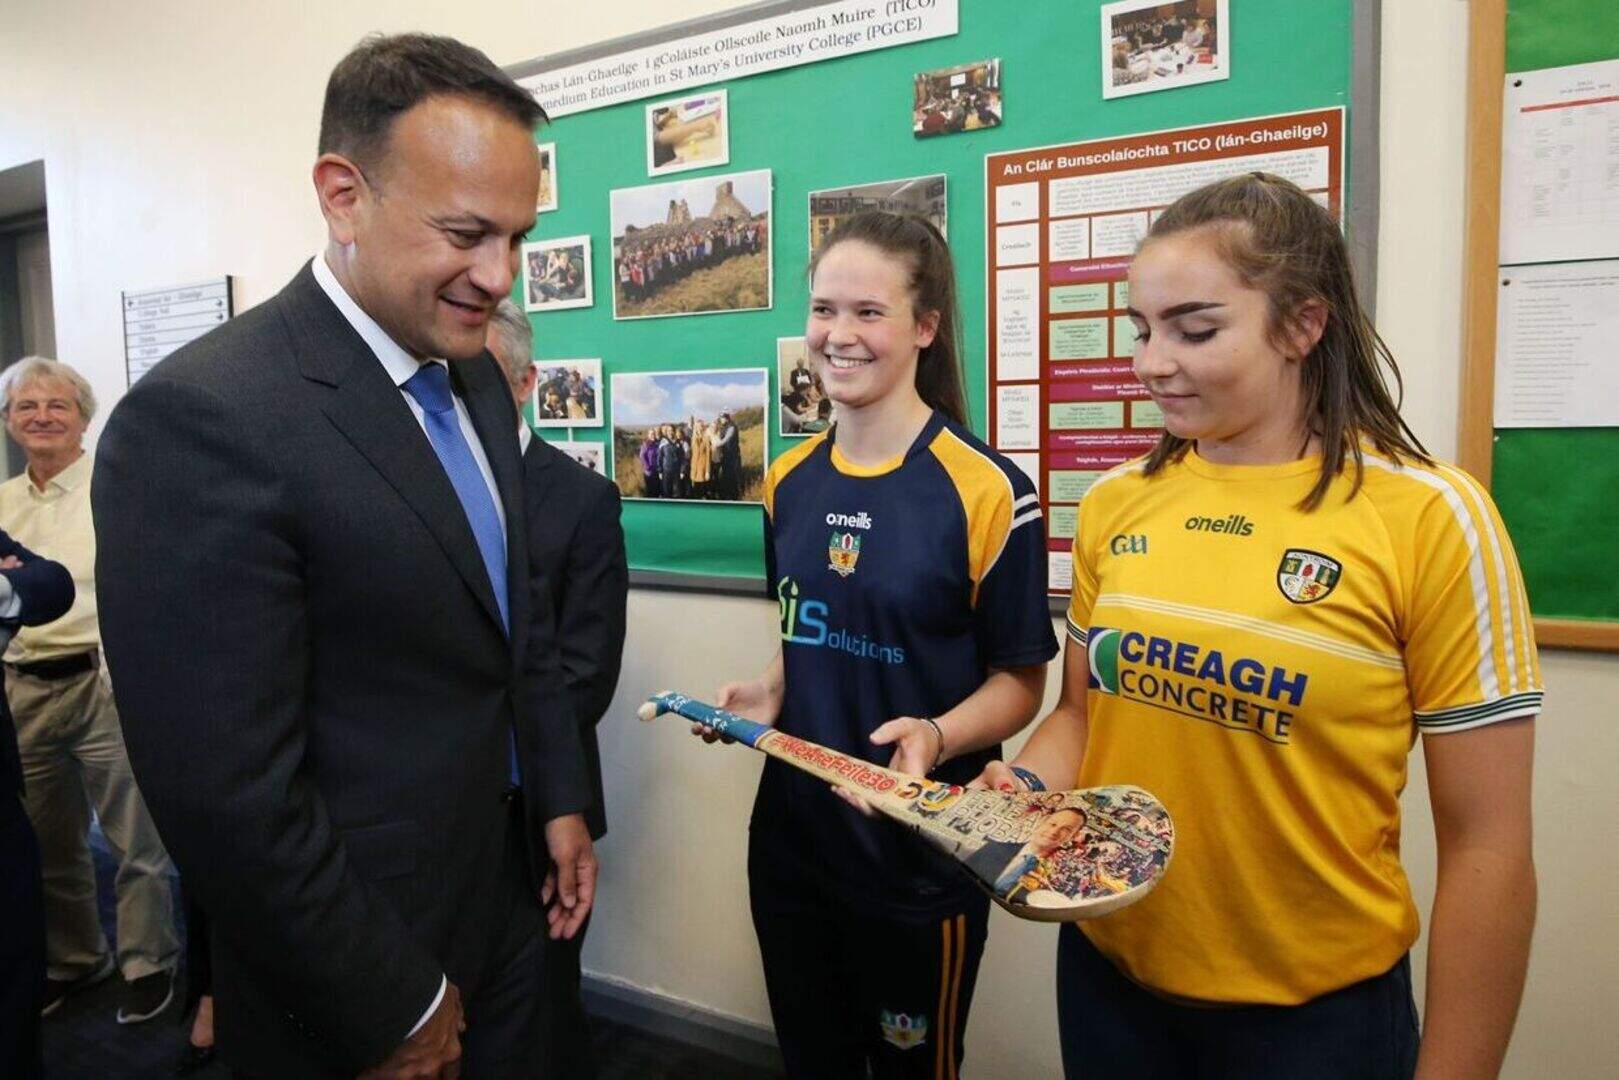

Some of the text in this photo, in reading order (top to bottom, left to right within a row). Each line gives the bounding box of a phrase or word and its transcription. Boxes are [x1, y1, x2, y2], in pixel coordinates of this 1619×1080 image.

[590, 78, 650, 100] Education
[654, 74, 667, 86] in
[670, 66, 684, 82] St
[688, 59, 731, 78] Mary's
[734, 42, 804, 66] University
[808, 31, 862, 52] College
[866, 16, 922, 41] (PGCE)
[714, 28, 772, 53] Ollscoile
[776, 17, 827, 38] Naomh
[832, 8, 876, 27] Muire
[1003, 121, 1328, 176] An Clár Bunscolaíochta TICO (lán-Ghaeilge)
[1119, 631, 1309, 707] CREAGH
[1119, 668, 1294, 737] CONCRETE
